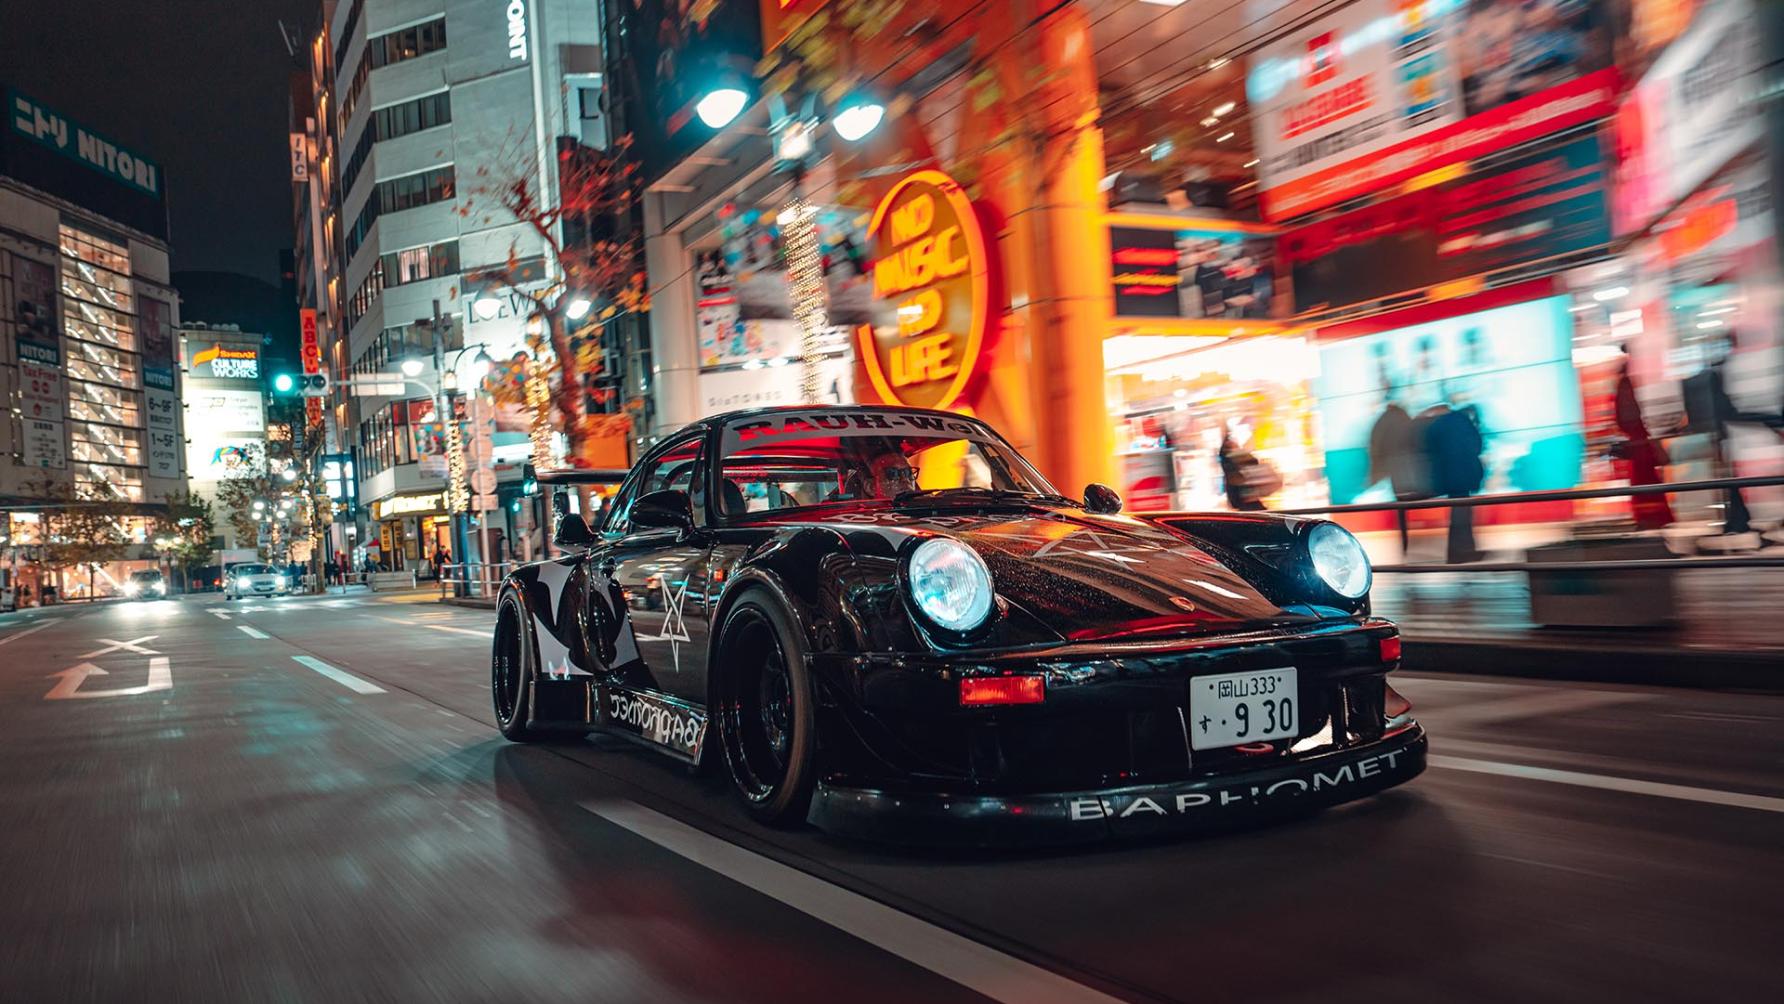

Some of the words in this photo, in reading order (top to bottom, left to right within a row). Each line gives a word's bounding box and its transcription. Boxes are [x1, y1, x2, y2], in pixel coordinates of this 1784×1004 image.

[16, 97, 68, 148] ニトリ
[77, 128, 156, 192] NITORI
[294, 137, 305, 175] ITC
[213, 367, 259, 378] WORKS
[1199, 715, 1212, 734] す
